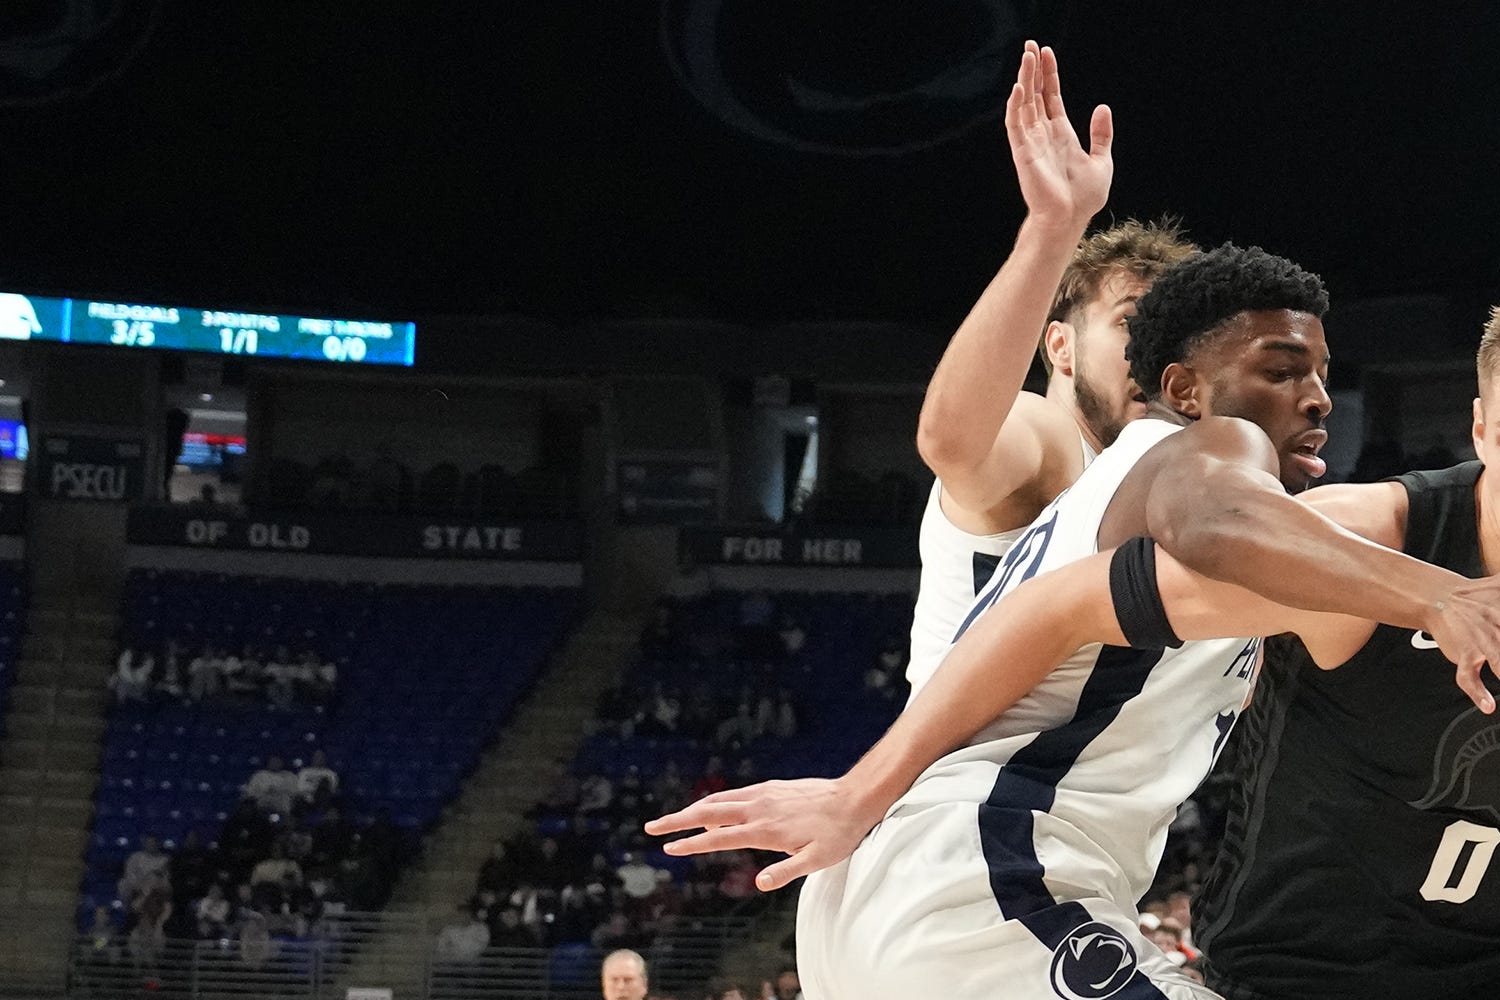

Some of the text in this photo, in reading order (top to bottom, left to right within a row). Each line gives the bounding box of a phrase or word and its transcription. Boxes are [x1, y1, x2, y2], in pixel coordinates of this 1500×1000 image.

[110, 319, 155, 347] 3/5
[219, 327, 258, 355] 1/1
[322, 336, 367, 362] 0/0
[185, 520, 310, 548] OF OLD
[422, 525, 523, 552] STATE
[722, 536, 863, 563] FOR HER
